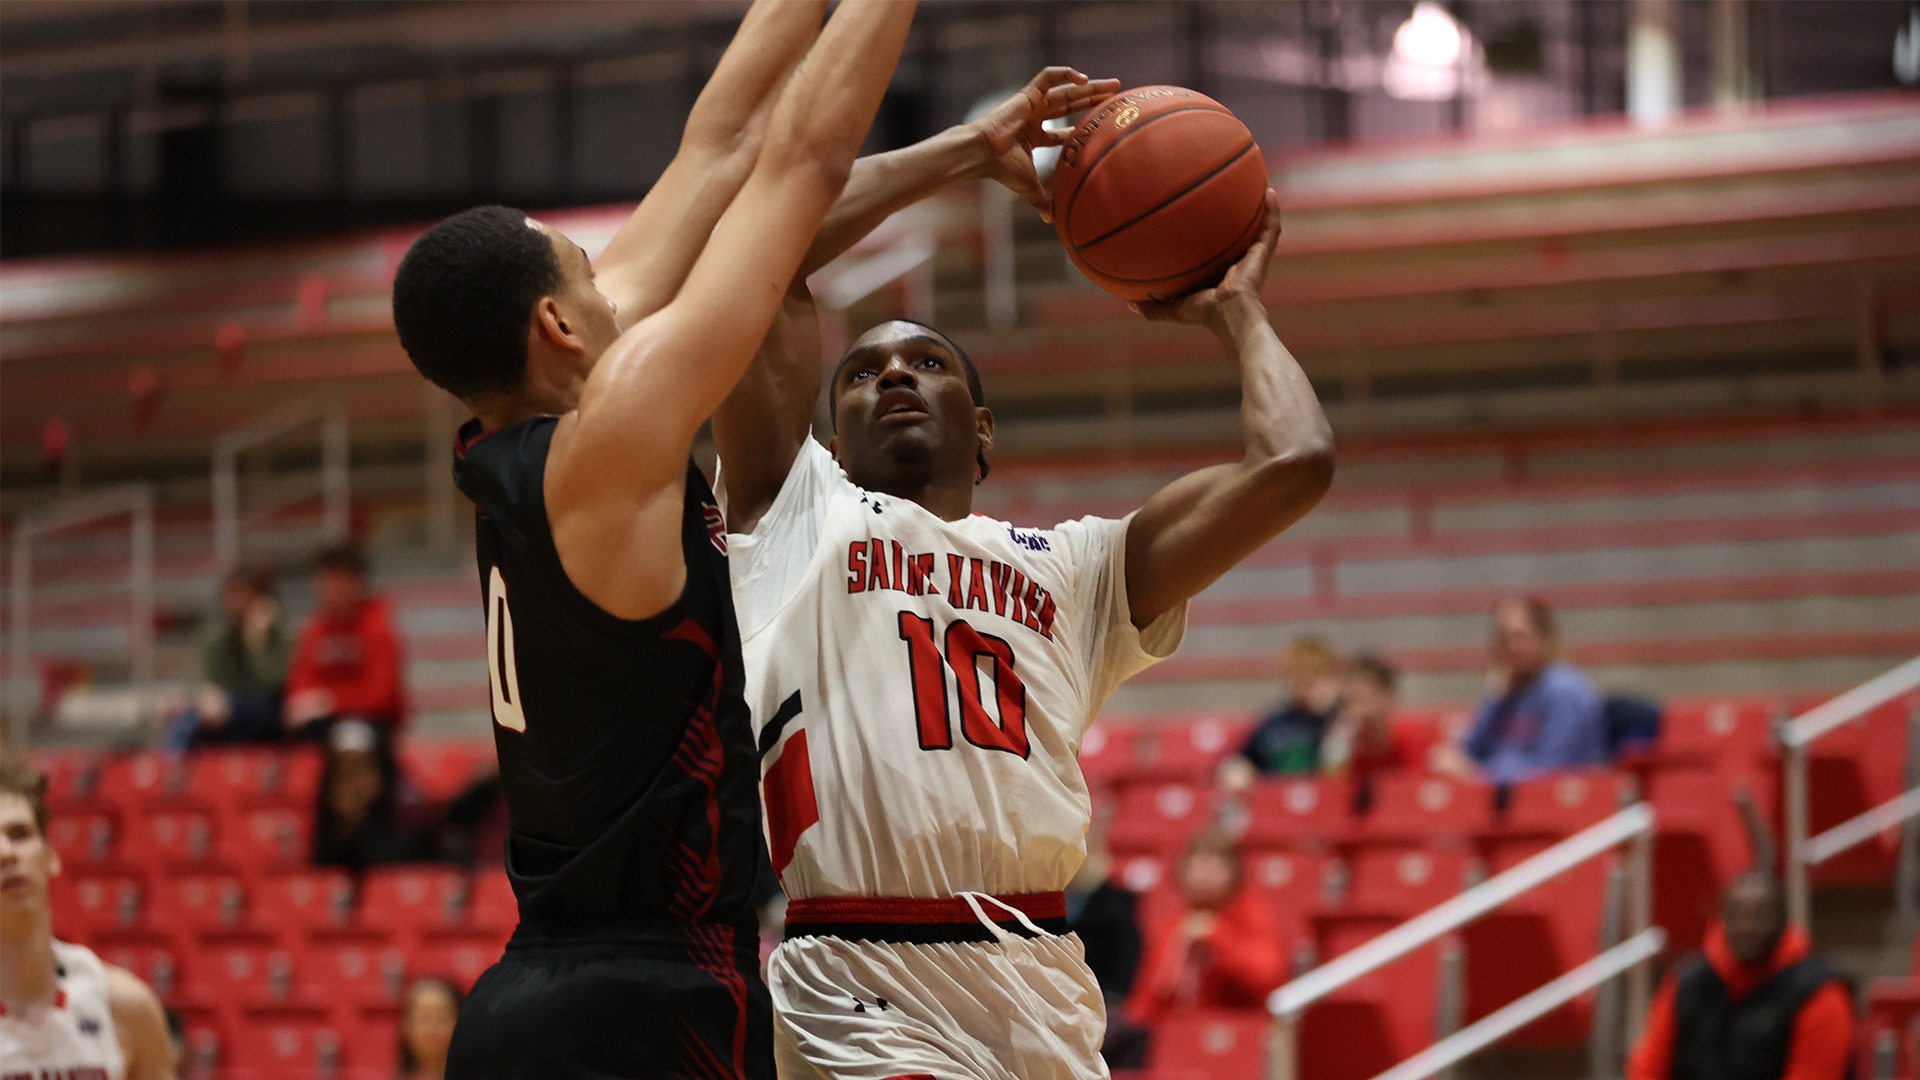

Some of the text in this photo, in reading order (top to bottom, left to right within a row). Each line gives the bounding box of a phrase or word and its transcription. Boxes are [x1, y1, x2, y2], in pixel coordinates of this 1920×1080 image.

[848, 538, 1056, 643] SAINT XAVIER
[898, 610, 1031, 761] 10
